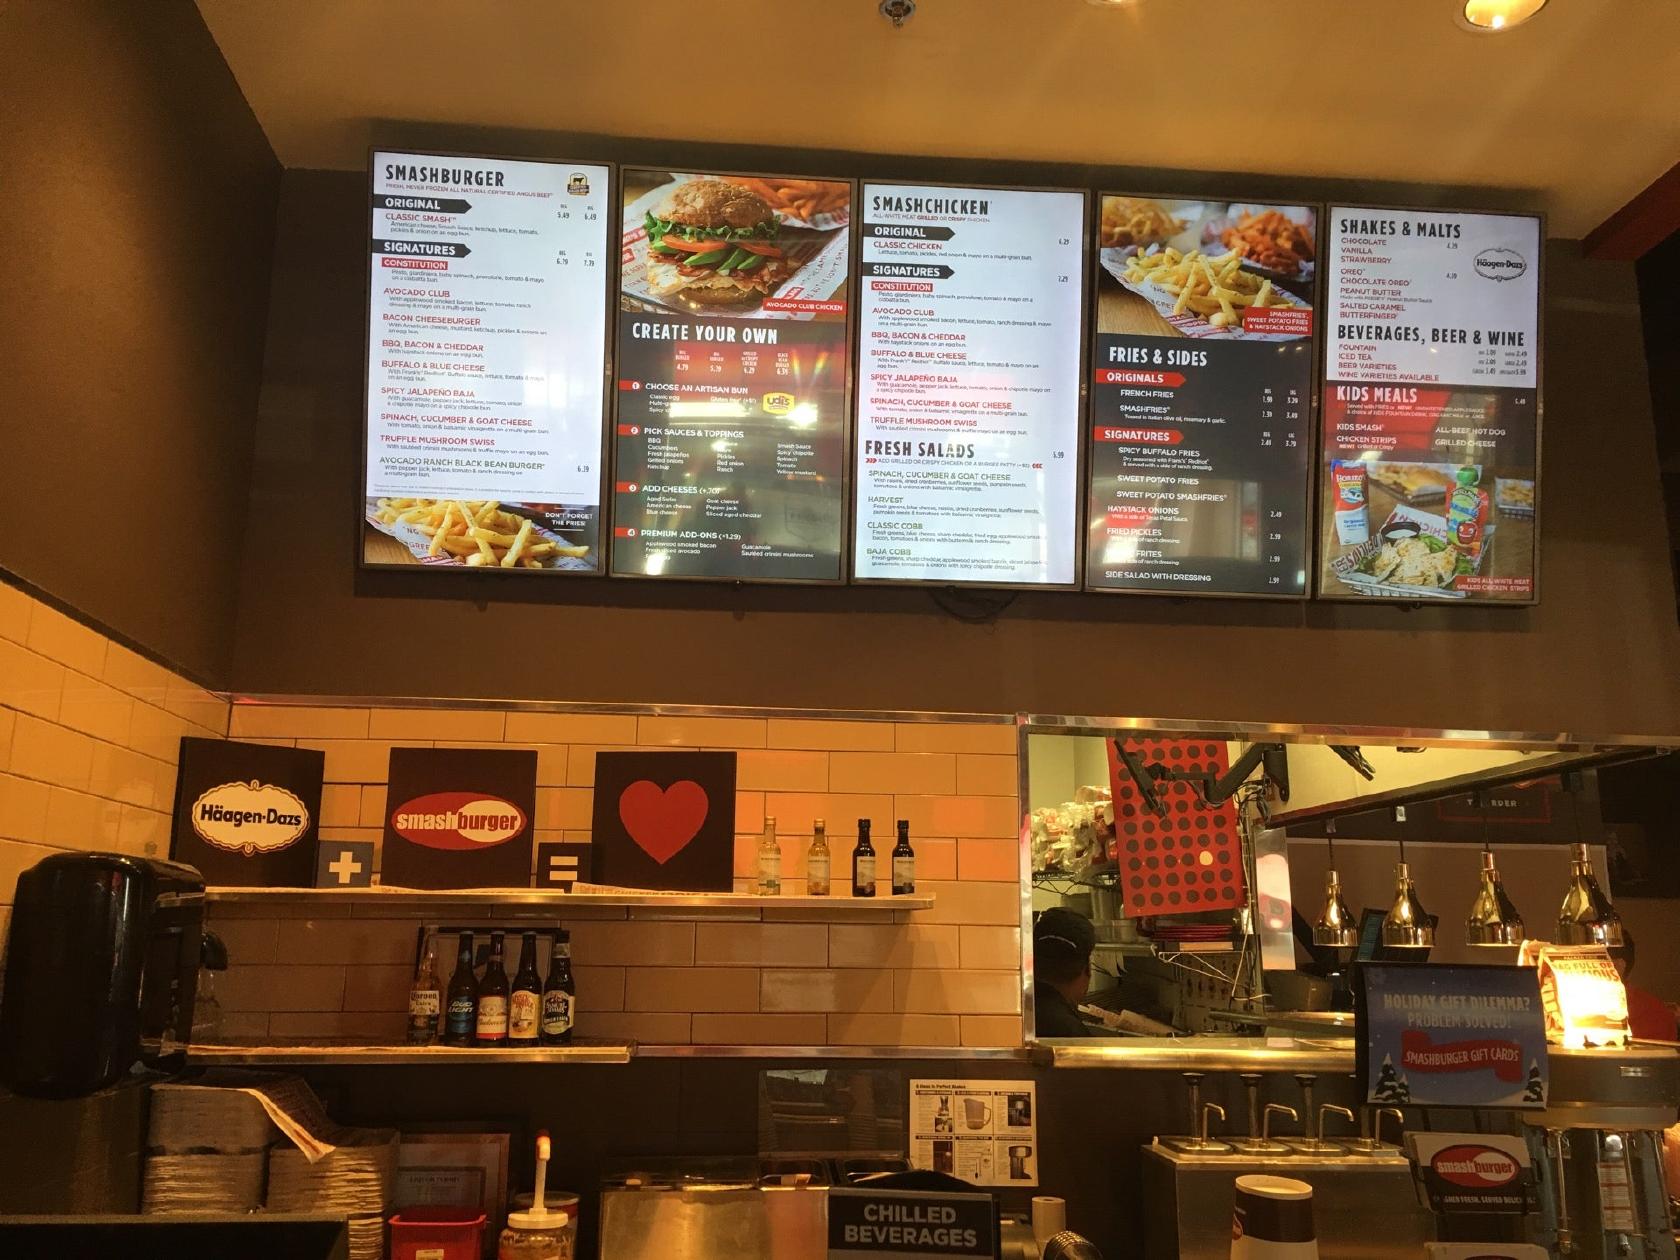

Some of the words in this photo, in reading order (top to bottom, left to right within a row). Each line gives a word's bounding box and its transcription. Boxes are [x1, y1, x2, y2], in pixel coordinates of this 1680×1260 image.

[386, 164, 504, 187] SMASHBURGER
[386, 198, 440, 210] ORIGINAL
[386, 214, 420, 222] CLASSIC
[875, 227, 926, 238] ORIGINAL
[1341, 219, 1395, 235] SHAKES
[1403, 223, 1411, 235] &
[1417, 223, 1461, 238] MALTS
[384, 242, 455, 255] SIGNATURES
[384, 259, 446, 269] CONSTITUTION
[1341, 256, 1392, 264] STRAWBERRY
[873, 265, 940, 277] SIGNATURES
[873, 282, 931, 291] CONSTITUTION
[384, 288, 425, 297] AVOCADO
[383, 314, 413, 322] BACON
[416, 315, 480, 325] CHEESEBURGER
[632, 323, 689, 340] CREATE
[696, 325, 736, 342] YOUR
[743, 328, 777, 344] OWN
[1338, 325, 1425, 344] BEVERAGES,
[1432, 328, 1467, 343] BEER
[1473, 331, 1482, 344] &
[1488, 331, 1524, 346] WINE
[444, 343, 484, 351] CHEDDAR
[1110, 347, 1148, 363] FRIES
[1153, 350, 1162, 364] &
[1168, 350, 1207, 366] SIDES
[382, 361, 421, 369] BUFFALO
[430, 362, 451, 370] BLUE
[453, 363, 484, 371] CHEESE
[1107, 372, 1163, 383] ORIGINALS
[381, 387, 404, 395] SPICY
[454, 389, 474, 397] BAJA
[646, 383, 679, 391] CHOOSE
[695, 385, 729, 393] ARTISAN
[1337, 386, 1368, 401] KIDS
[1374, 388, 1417, 403] MEALS
[381, 413, 419, 422] SPINACH,
[421, 415, 467, 424] CUCUMBER
[476, 417, 499, 425] GOAT
[501, 418, 532, 426] CHEESE
[704, 430, 744, 438] TOPPINGS
[1105, 430, 1170, 441] SIGNATURES
[380, 435, 416, 443] TRUFFLE
[419, 436, 467, 445] MUSHROOM
[866, 441, 911, 456] FRESH
[919, 443, 974, 458] SALADS
[1179, 449, 1200, 457] FRIES
[380, 457, 421, 465] AVOCADO
[424, 458, 453, 466] RANCH
[455, 459, 482, 467] BLACK
[484, 460, 507, 468] BEAN
[1146, 476, 1176, 484] POTATO
[662, 486, 697, 494] CHEESES
[397, 813, 517, 830] smashburger
[1384, 994, 1436, 1009] HOLIDAY
[1439, 995, 1467, 1009] GIFT
[1470, 996, 1530, 1011] DILEMMA?
[1408, 1014, 1462, 1028] PROBLEM
[1465, 1015, 1510, 1029] SOLVED!
[1406, 1051, 1468, 1065] SMASHBURGER
[1471, 1050, 1488, 1061] GIFT
[1491, 1048, 1519, 1061] CARDS
[1437, 1161, 1513, 1174] smashburger
[864, 1204, 956, 1223] CHILLED
[845, 1225, 976, 1246] BEVERAGES
